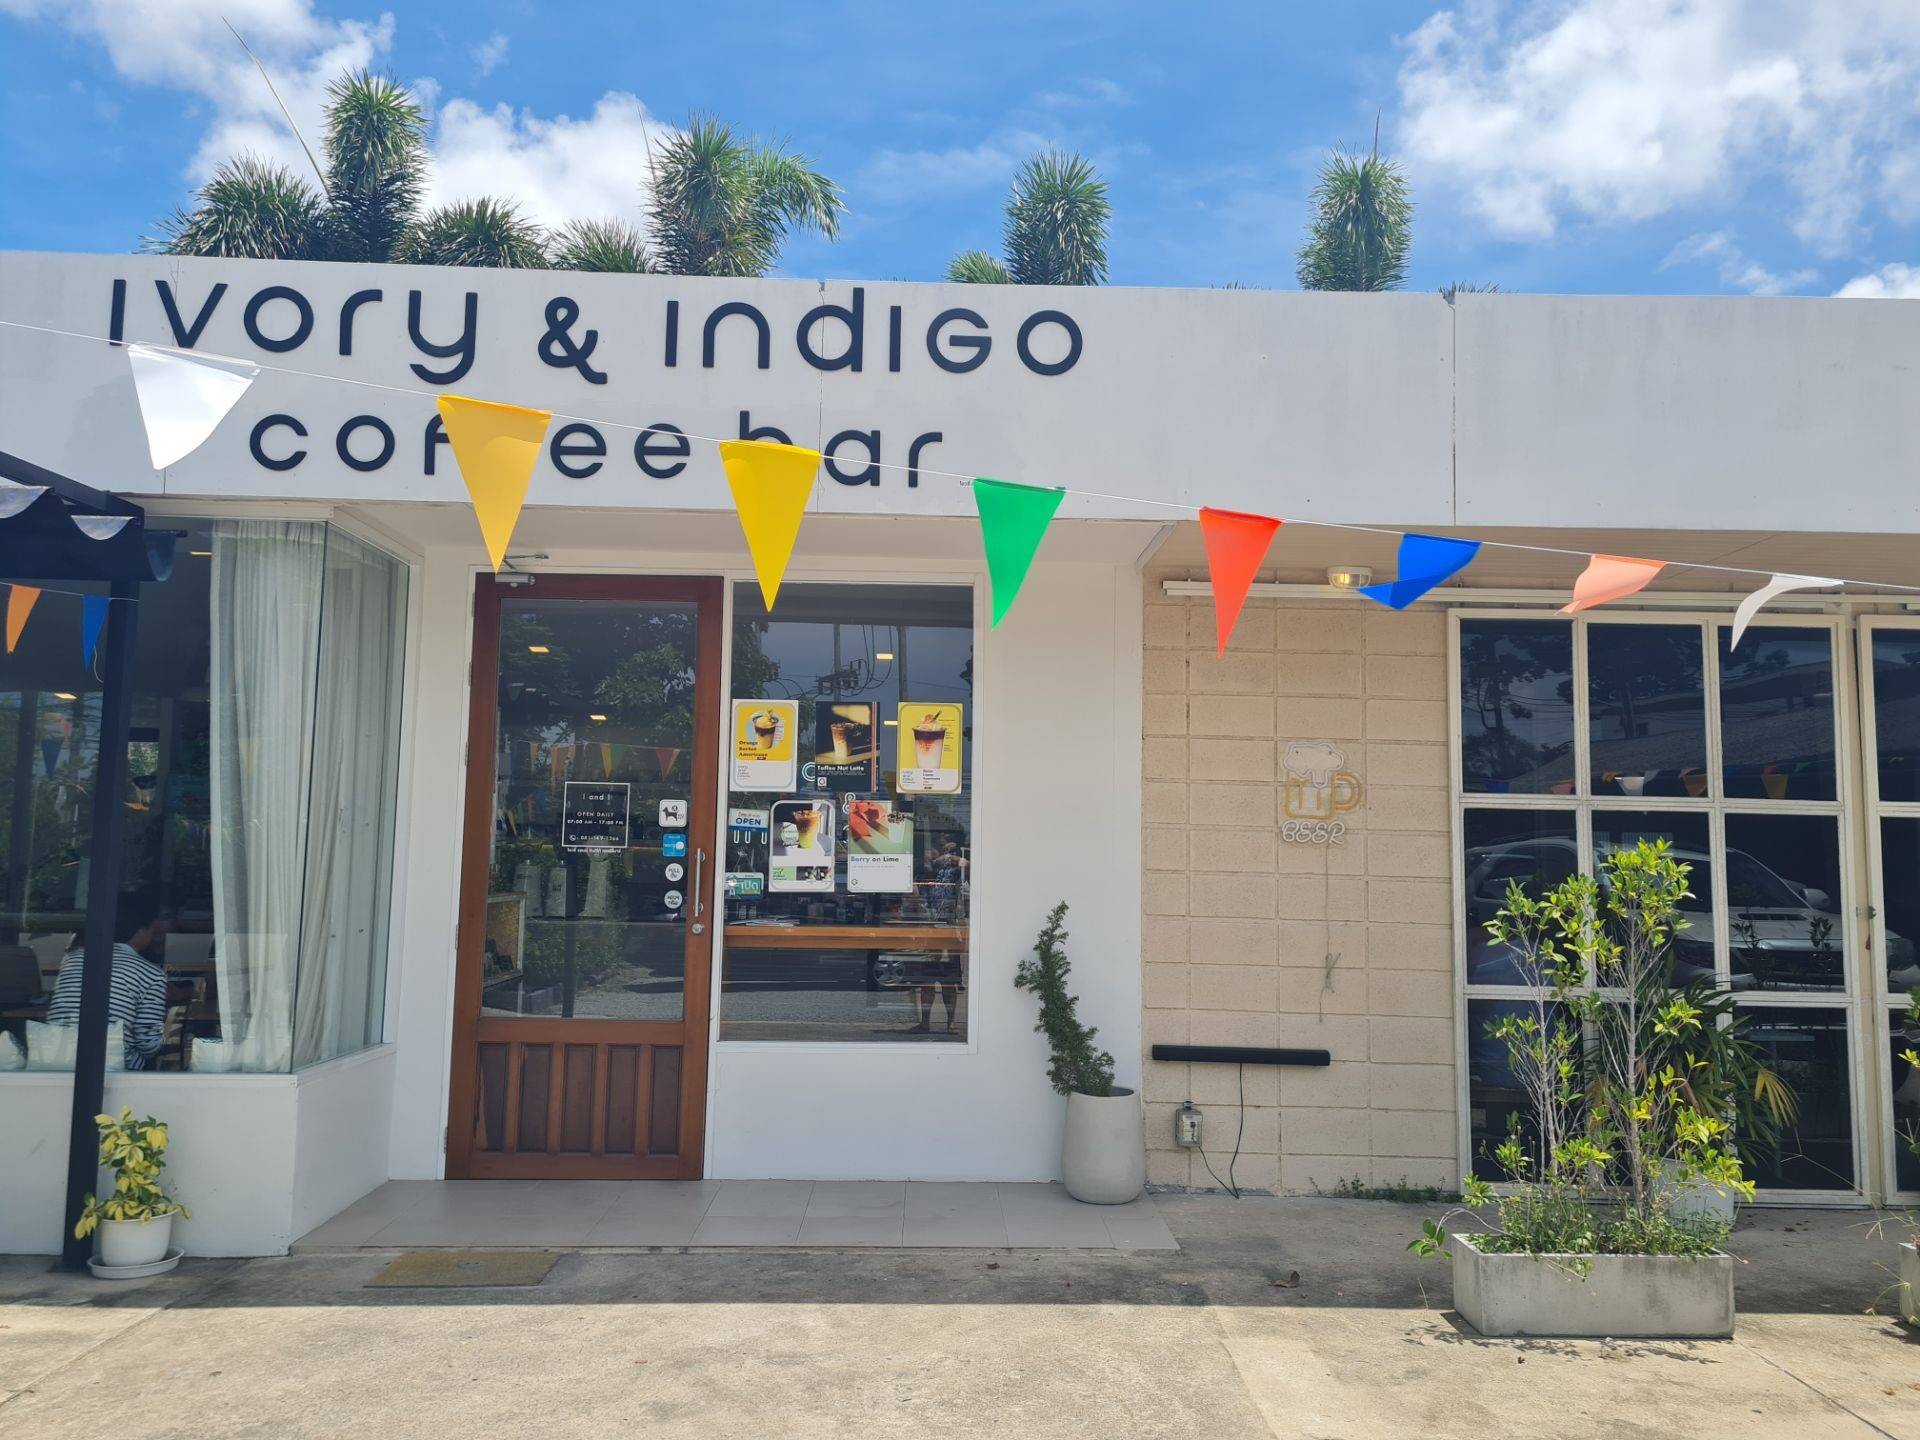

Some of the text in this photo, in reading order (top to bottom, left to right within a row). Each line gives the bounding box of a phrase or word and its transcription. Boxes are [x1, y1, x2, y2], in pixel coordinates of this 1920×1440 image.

[537, 296, 609, 386] &
[248, 413, 692, 479] cofee
[588, 793, 605, 801] and
[735, 817, 761, 826] OPEN
[1281, 820, 1345, 845] BEER
[883, 855, 900, 863] Lime
